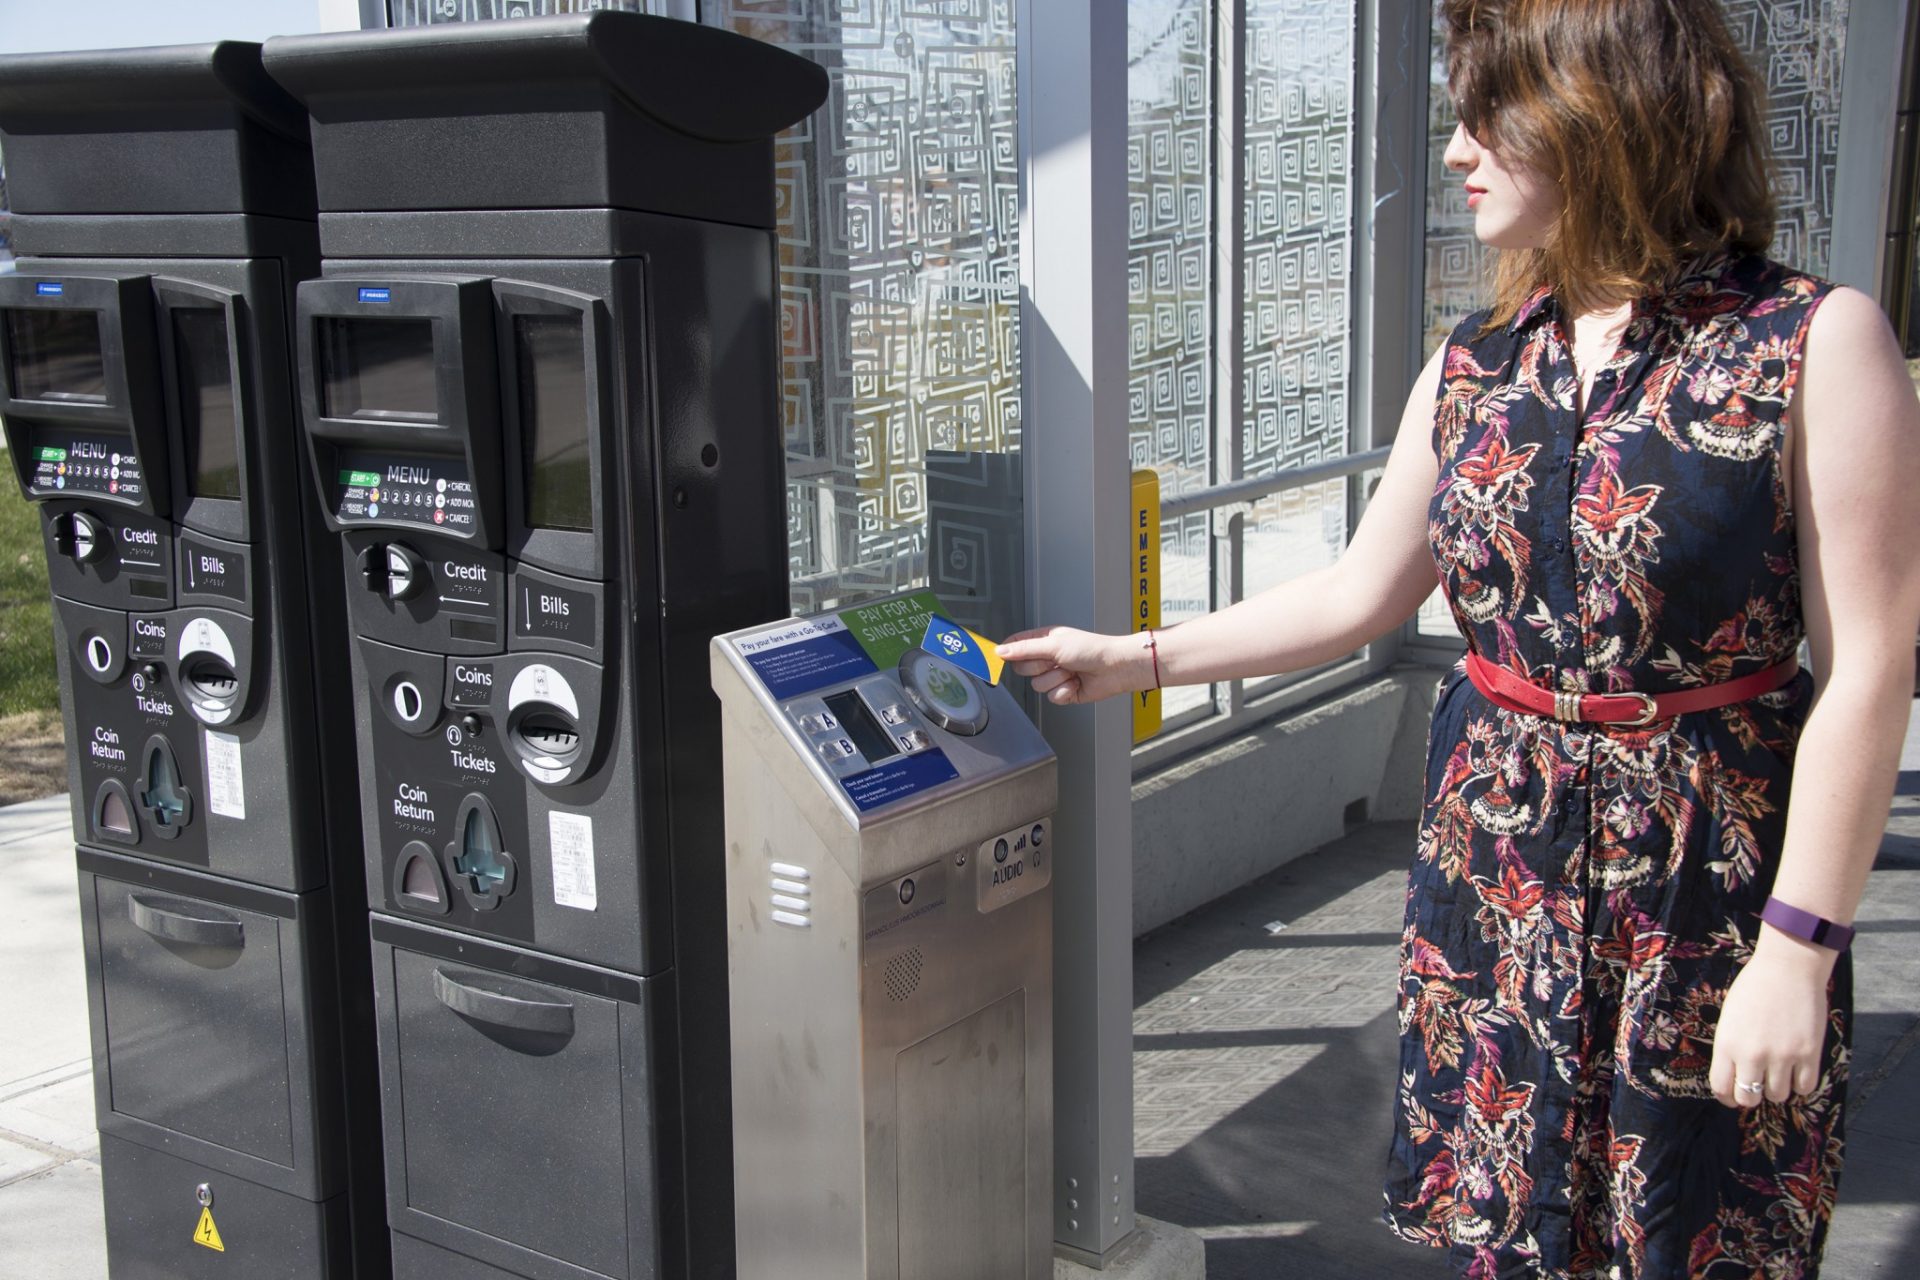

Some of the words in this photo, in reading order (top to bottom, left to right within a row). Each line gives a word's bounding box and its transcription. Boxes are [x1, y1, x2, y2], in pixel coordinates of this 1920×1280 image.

[72, 442, 107, 459] MENU
[387, 465, 430, 485] MENU
[123, 527, 158, 545] Credit
[201, 555, 225, 575] Bills
[444, 561, 487, 582] Credit
[540, 594, 570, 616] Bills
[857, 607, 883, 624] PAY
[882, 599, 910, 618] FOR
[910, 598, 923, 611] A
[1139, 509, 1148, 708] EMERGY
[136, 619, 166, 639] Coins
[741, 642, 755, 651] Pay
[755, 639, 769, 649] your
[769, 635, 784, 645] fare
[784, 631, 799, 641] with
[822, 621, 838, 631] Card
[862, 618, 912, 642] SINGLE
[943, 634, 962, 648] go
[950, 644, 960, 653] to
[455, 665, 493, 687] Coins
[136, 695, 173, 717] Tickets
[821, 713, 835, 728] A
[881, 710, 894, 724] C
[95, 726, 119, 745] Coin
[900, 736, 913, 751] D
[92, 742, 125, 762] Return
[838, 739, 853, 754] B
[450, 750, 496, 774] Tickets
[399, 783, 428, 803] Coin
[394, 799, 435, 823] Return
[992, 860, 1024, 888] AUDIO
